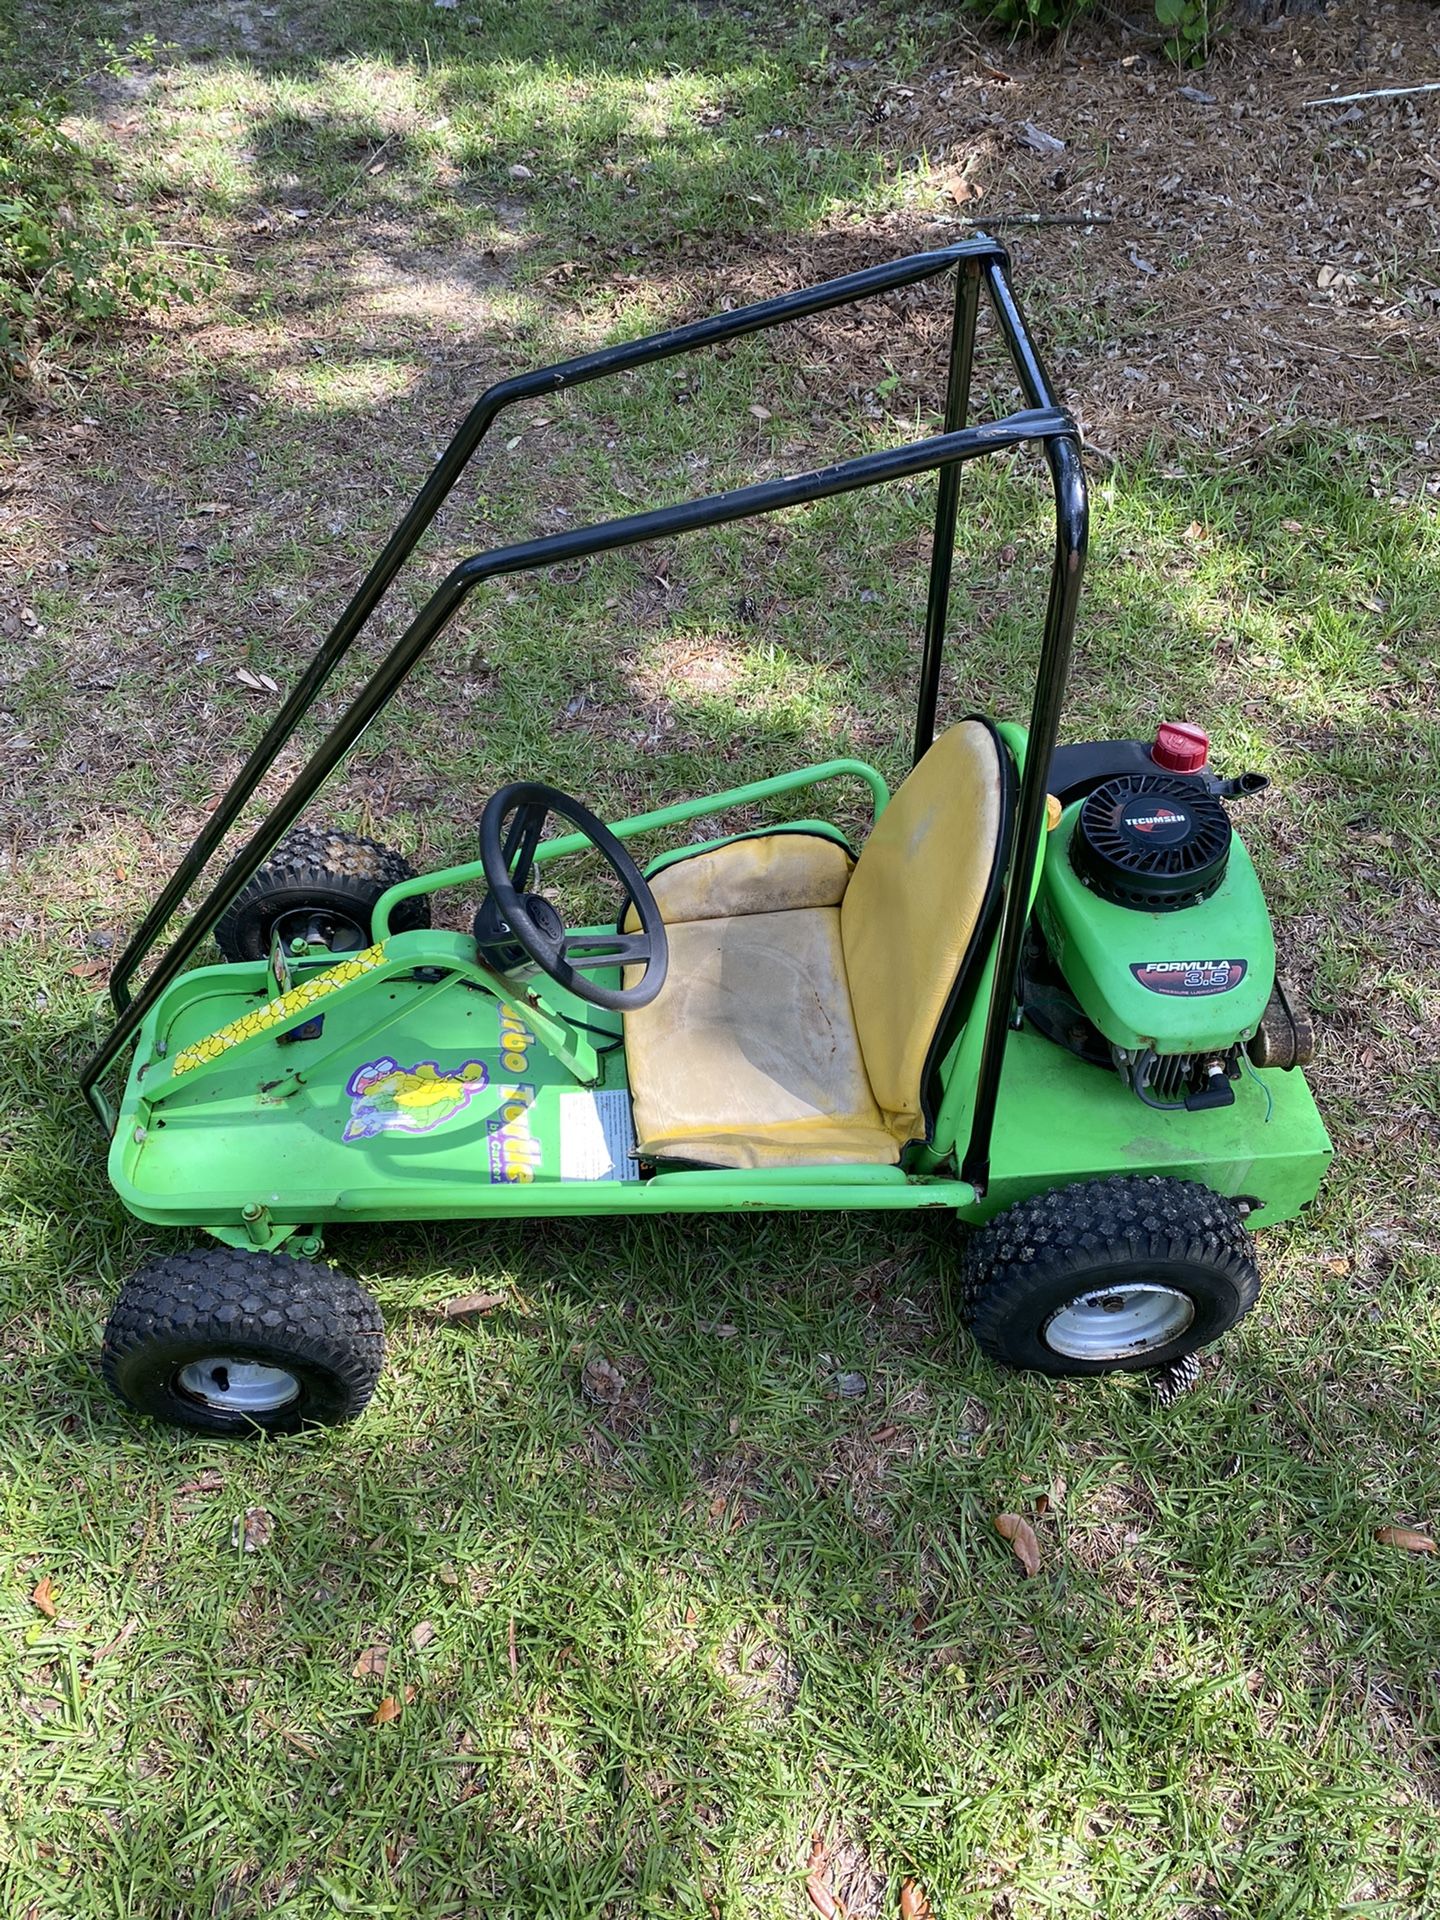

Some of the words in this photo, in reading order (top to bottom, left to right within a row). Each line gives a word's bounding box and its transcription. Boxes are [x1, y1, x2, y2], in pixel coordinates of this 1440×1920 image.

[1124, 814, 1186, 826] TECUMSEH
[1145, 960, 1231, 973] FORMULA
[1184, 969, 1229, 987] 3.5
[497, 1002, 536, 1073] urbo
